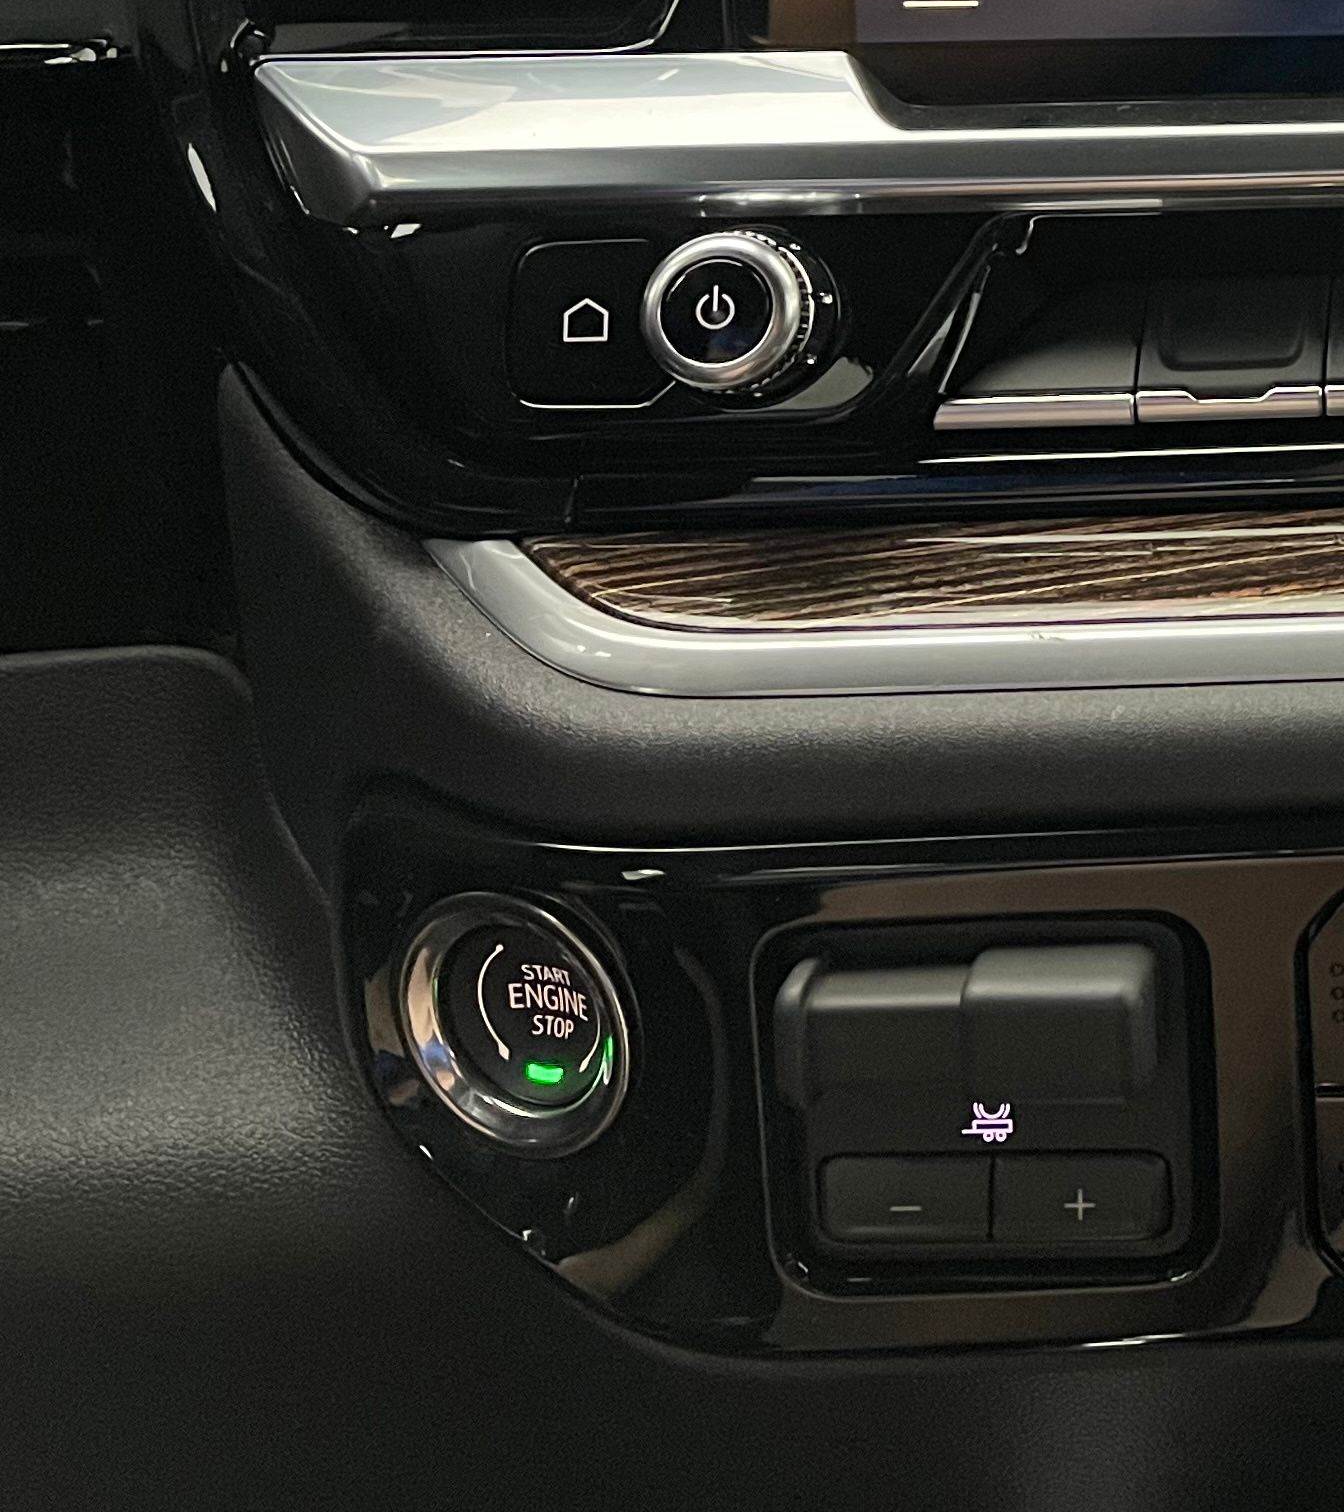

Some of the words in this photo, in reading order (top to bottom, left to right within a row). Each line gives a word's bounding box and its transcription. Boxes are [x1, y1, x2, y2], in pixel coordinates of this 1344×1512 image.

[521, 964, 571, 987] START
[508, 982, 588, 1022] ENGINE
[531, 1014, 575, 1039] STOP
